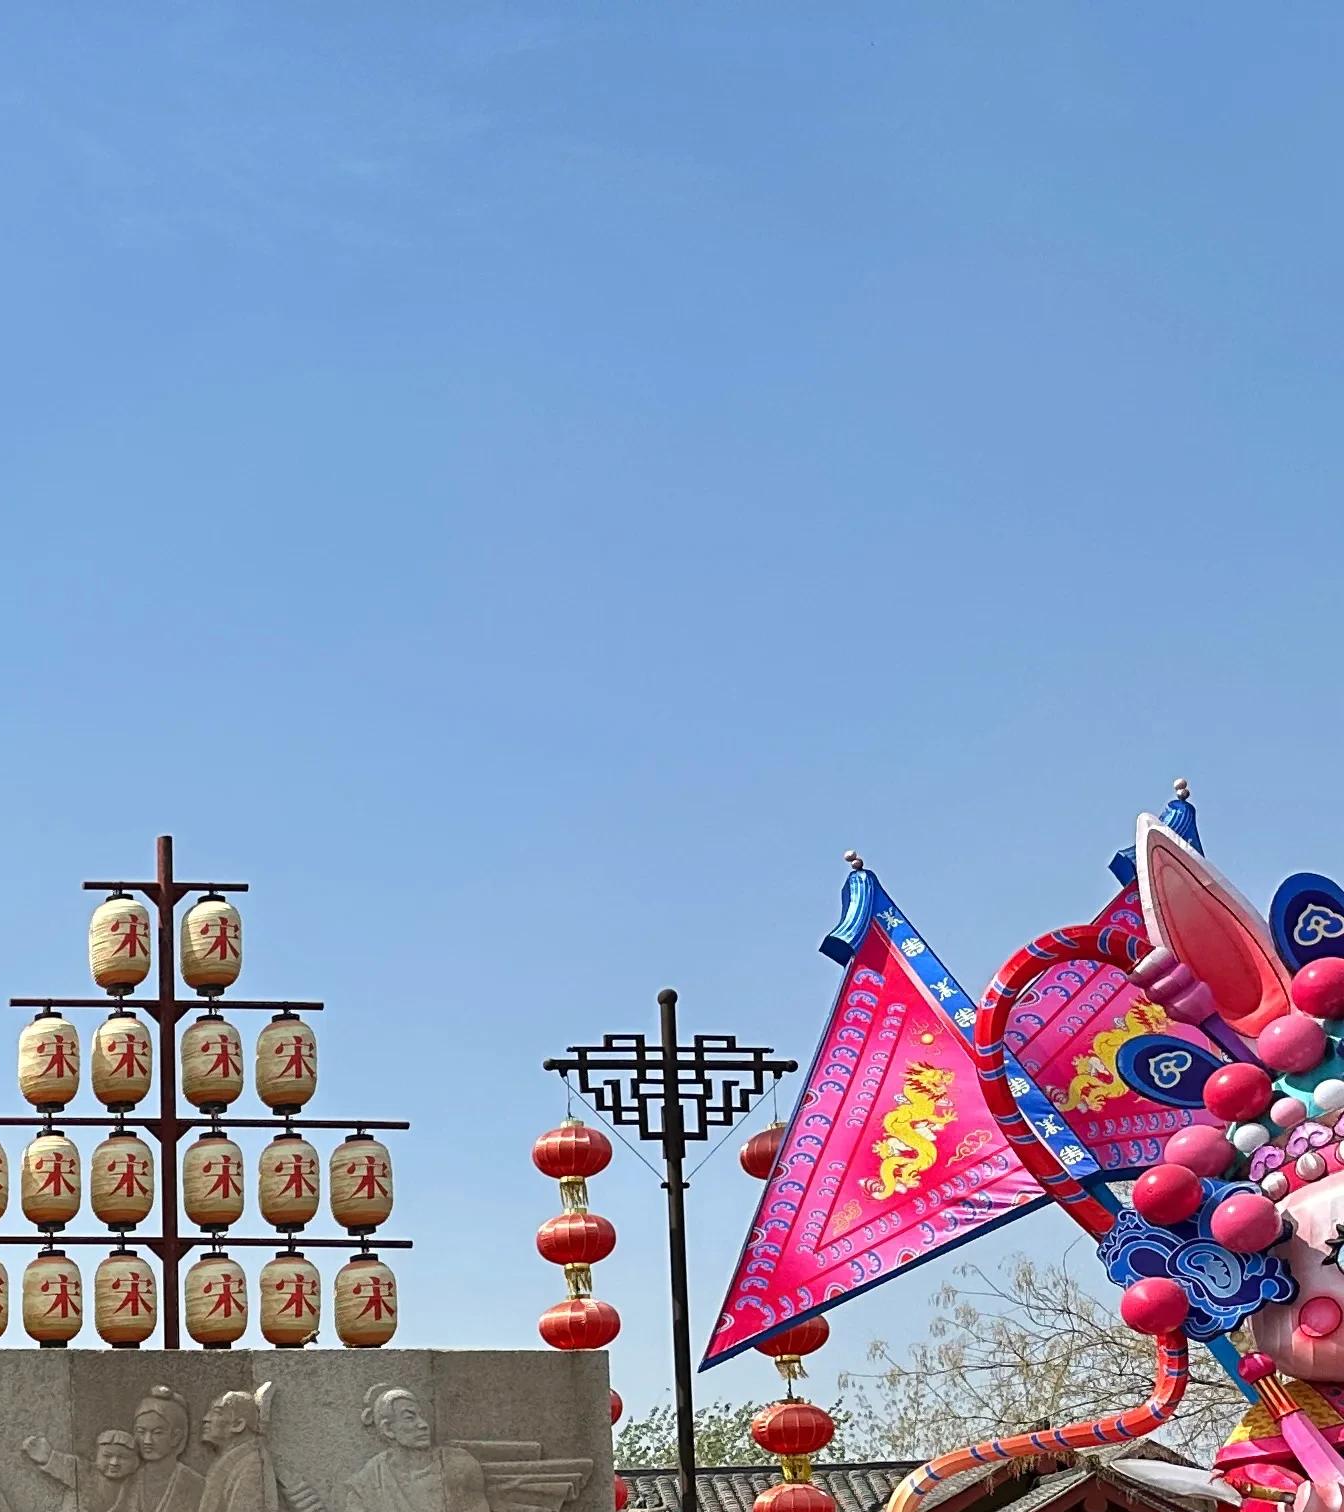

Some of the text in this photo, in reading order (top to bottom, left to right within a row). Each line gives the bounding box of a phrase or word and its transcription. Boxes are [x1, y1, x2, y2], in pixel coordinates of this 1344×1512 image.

[111, 914, 150, 959] 宋
[200, 917, 239, 960] 宋
[37, 1034, 77, 1078] 宋
[107, 1034, 148, 1077] 宋
[201, 1034, 242, 1078] 宋
[275, 1035, 315, 1079] 宋
[35, 1153, 76, 1196] 宋
[107, 1154, 148, 1197] 宋
[202, 1154, 242, 1199] 宋
[274, 1154, 316, 1198] 宋
[347, 1155, 388, 1199] 宋
[41, 1274, 82, 1318] 宋
[111, 1272, 153, 1316] 宋
[202, 1274, 245, 1318] 宋
[275, 1274, 318, 1318] 宋
[353, 1276, 394, 1320] 宋
